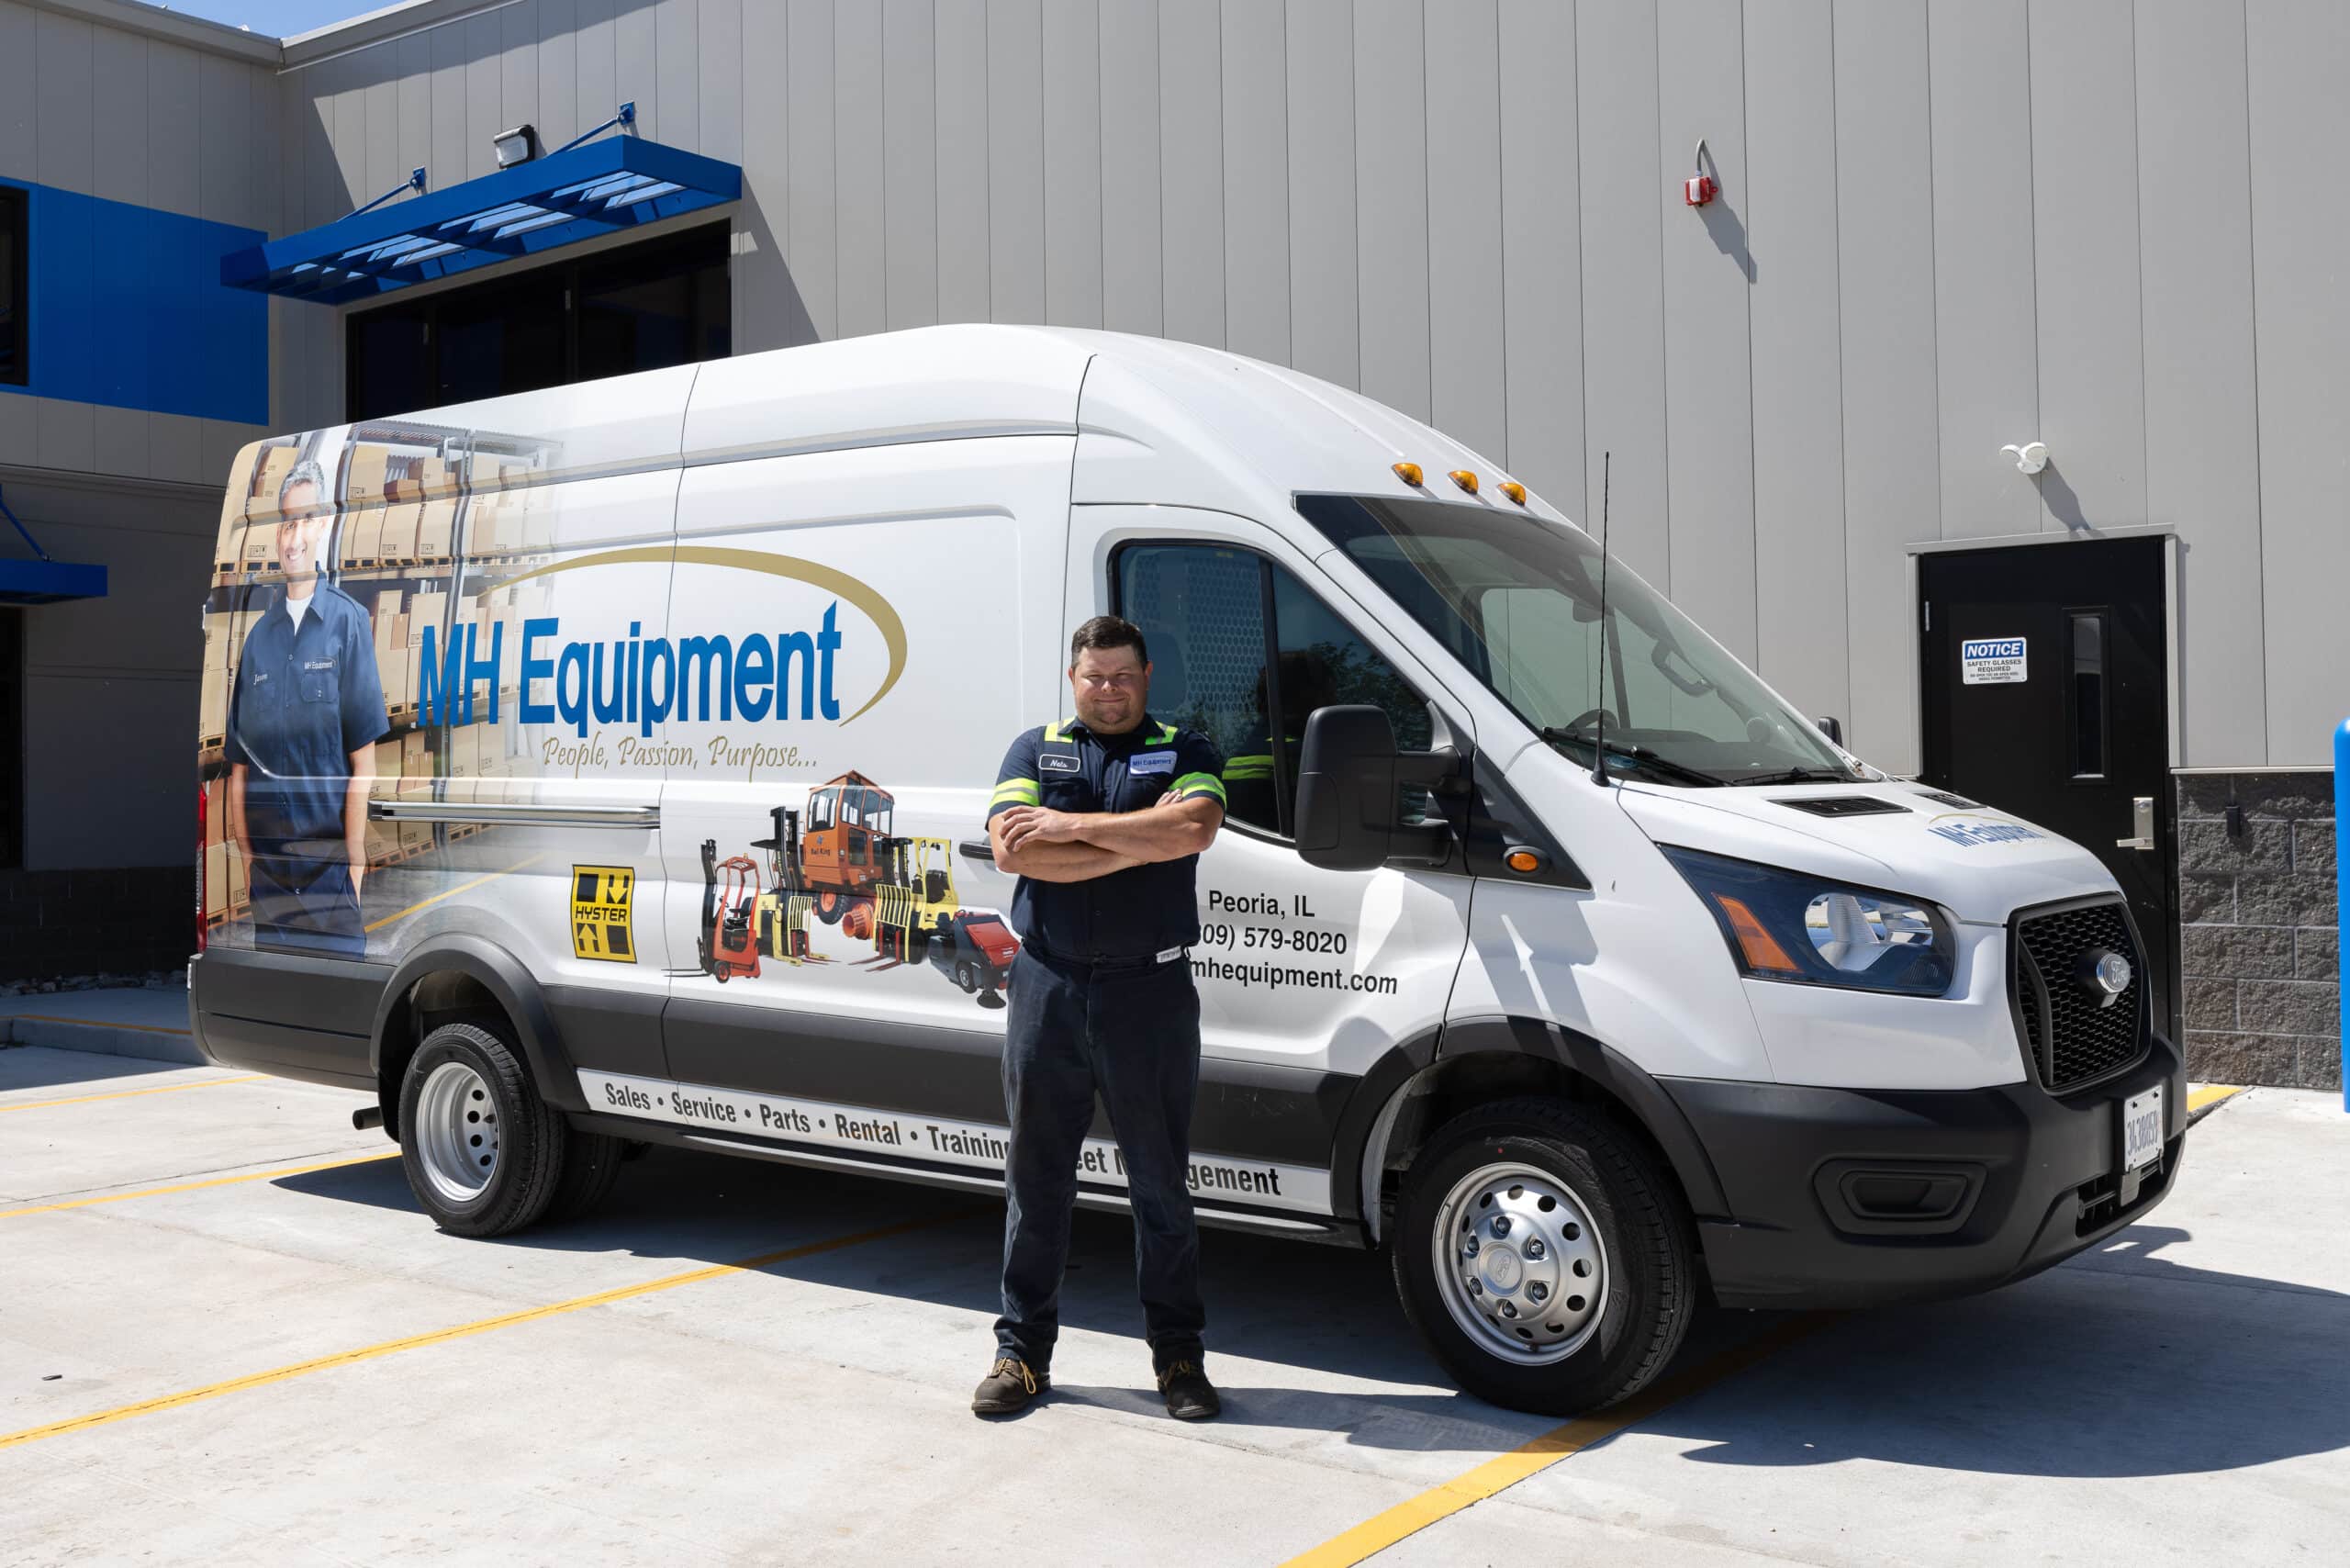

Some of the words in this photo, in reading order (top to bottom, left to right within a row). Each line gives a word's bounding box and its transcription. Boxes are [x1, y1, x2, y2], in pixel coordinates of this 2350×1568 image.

[1966, 643, 2021, 657] NOTICE
[419, 621, 503, 726] MH
[519, 600, 842, 739] Equipment
[543, 731, 610, 780] People,
[617, 735, 698, 770] Passion,
[708, 735, 818, 784] Purpose...
[576, 905, 628, 923] HYSTER
[1209, 890, 1286, 920] Peoria,
[1295, 894, 1315, 918] IL
[1201, 924, 1236, 951] 09)
[1244, 926, 1348, 955] 579-8020
[605, 1082, 651, 1111] Sales
[671, 1091, 737, 1124] Service
[759, 1103, 811, 1134] Parts
[835, 1114, 901, 1146] Rental
